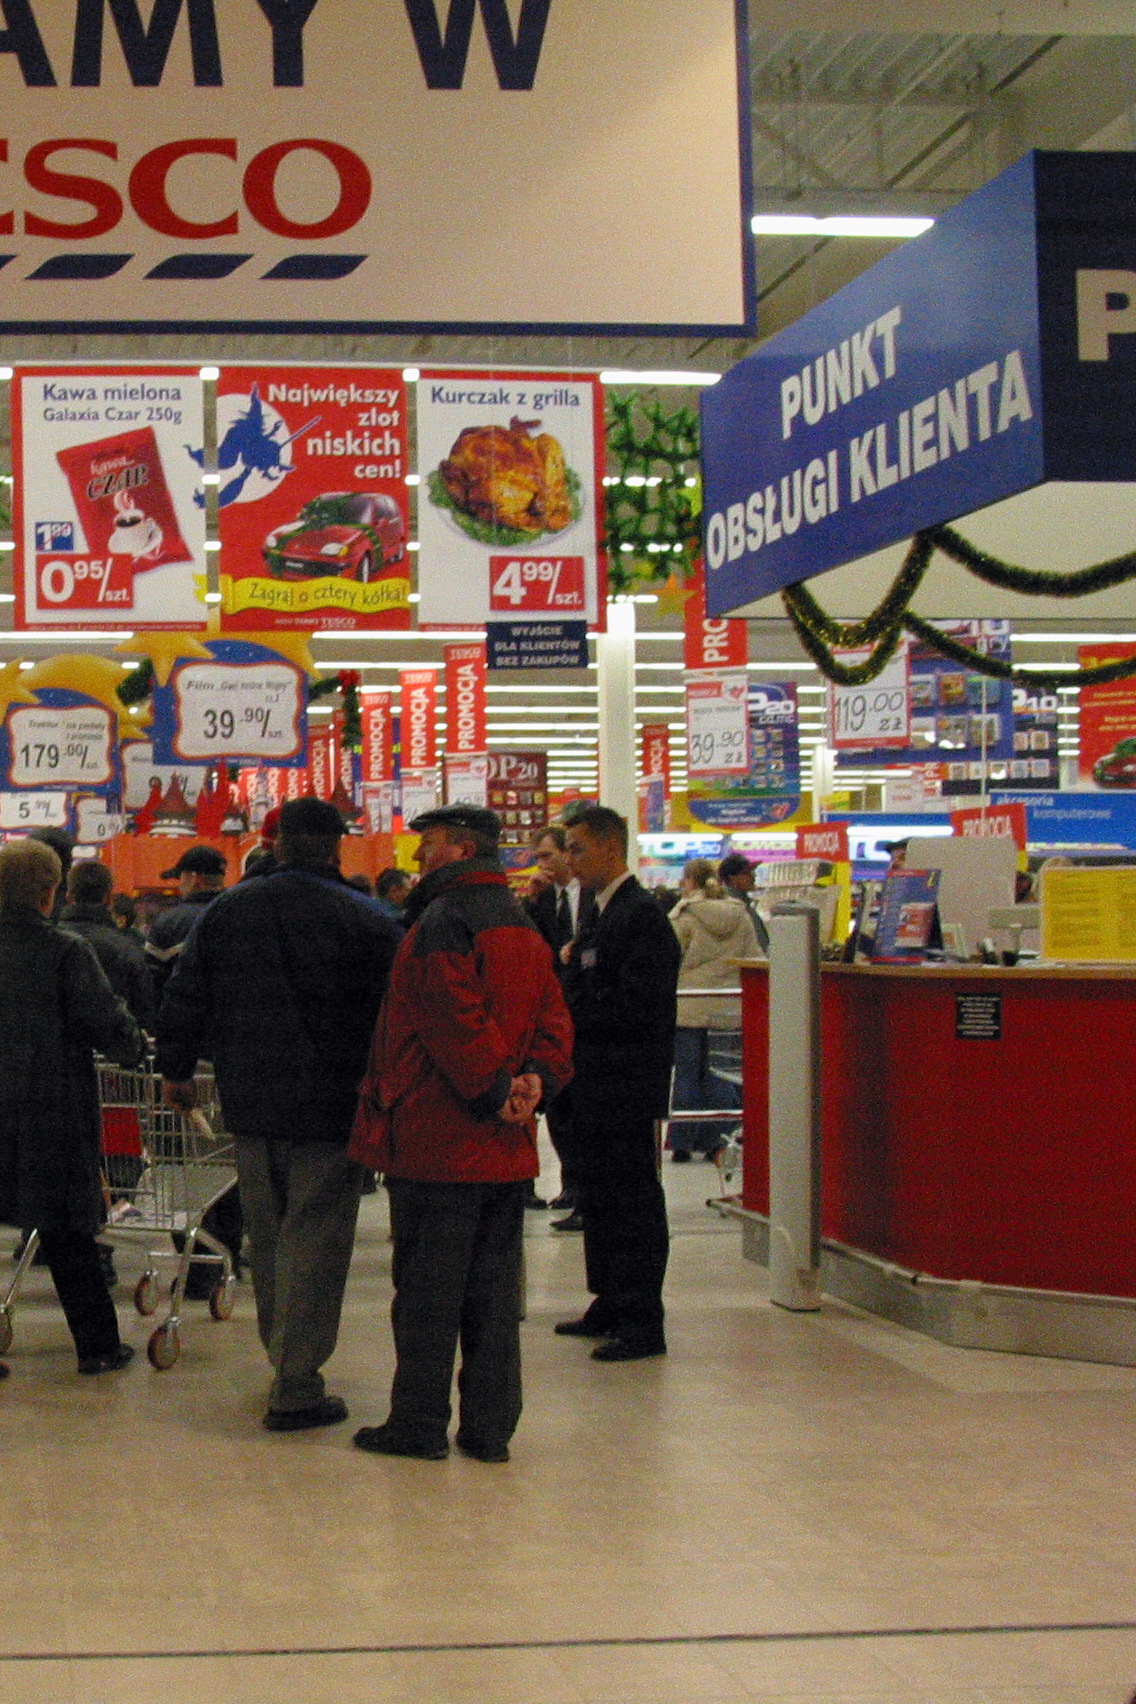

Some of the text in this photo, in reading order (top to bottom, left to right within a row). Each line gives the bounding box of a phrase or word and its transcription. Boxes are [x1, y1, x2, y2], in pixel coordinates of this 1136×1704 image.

[405, 0, 553, 91] W
[1076, 268, 1136, 362] P
[781, 305, 902, 441] PUNKT
[43, 383, 182, 401] Kawa mielona
[268, 383, 400, 408] Największy
[431, 385, 581, 410] Kurczak z grilla
[43, 406, 183, 425] Galaxia Czar 250g
[357, 407, 401, 427] zlot
[306, 430, 402, 456] niskich
[354, 459, 402, 479] cen!
[705, 348, 1034, 572] OBSŁUGI KLIENTA
[249, 582, 294, 606] Zagraj
[299, 592, 308, 601] o
[314, 583, 358, 609] cztery
[511, 624, 563, 636] WYJŚCIE
[494, 638, 581, 651] DLA KLIENTÓW
[496, 654, 581, 665] BEZ ZAKUPÓW
[457, 663, 479, 750] PROMOCJA
[410, 687, 430, 766] PROMOCJA
[369, 707, 387, 780] PROMOCJA
[996, 793, 1054, 807] akcesoria
[1033, 808, 1112, 822] komputerowe
[803, 830, 840, 855] PROMOCJA
